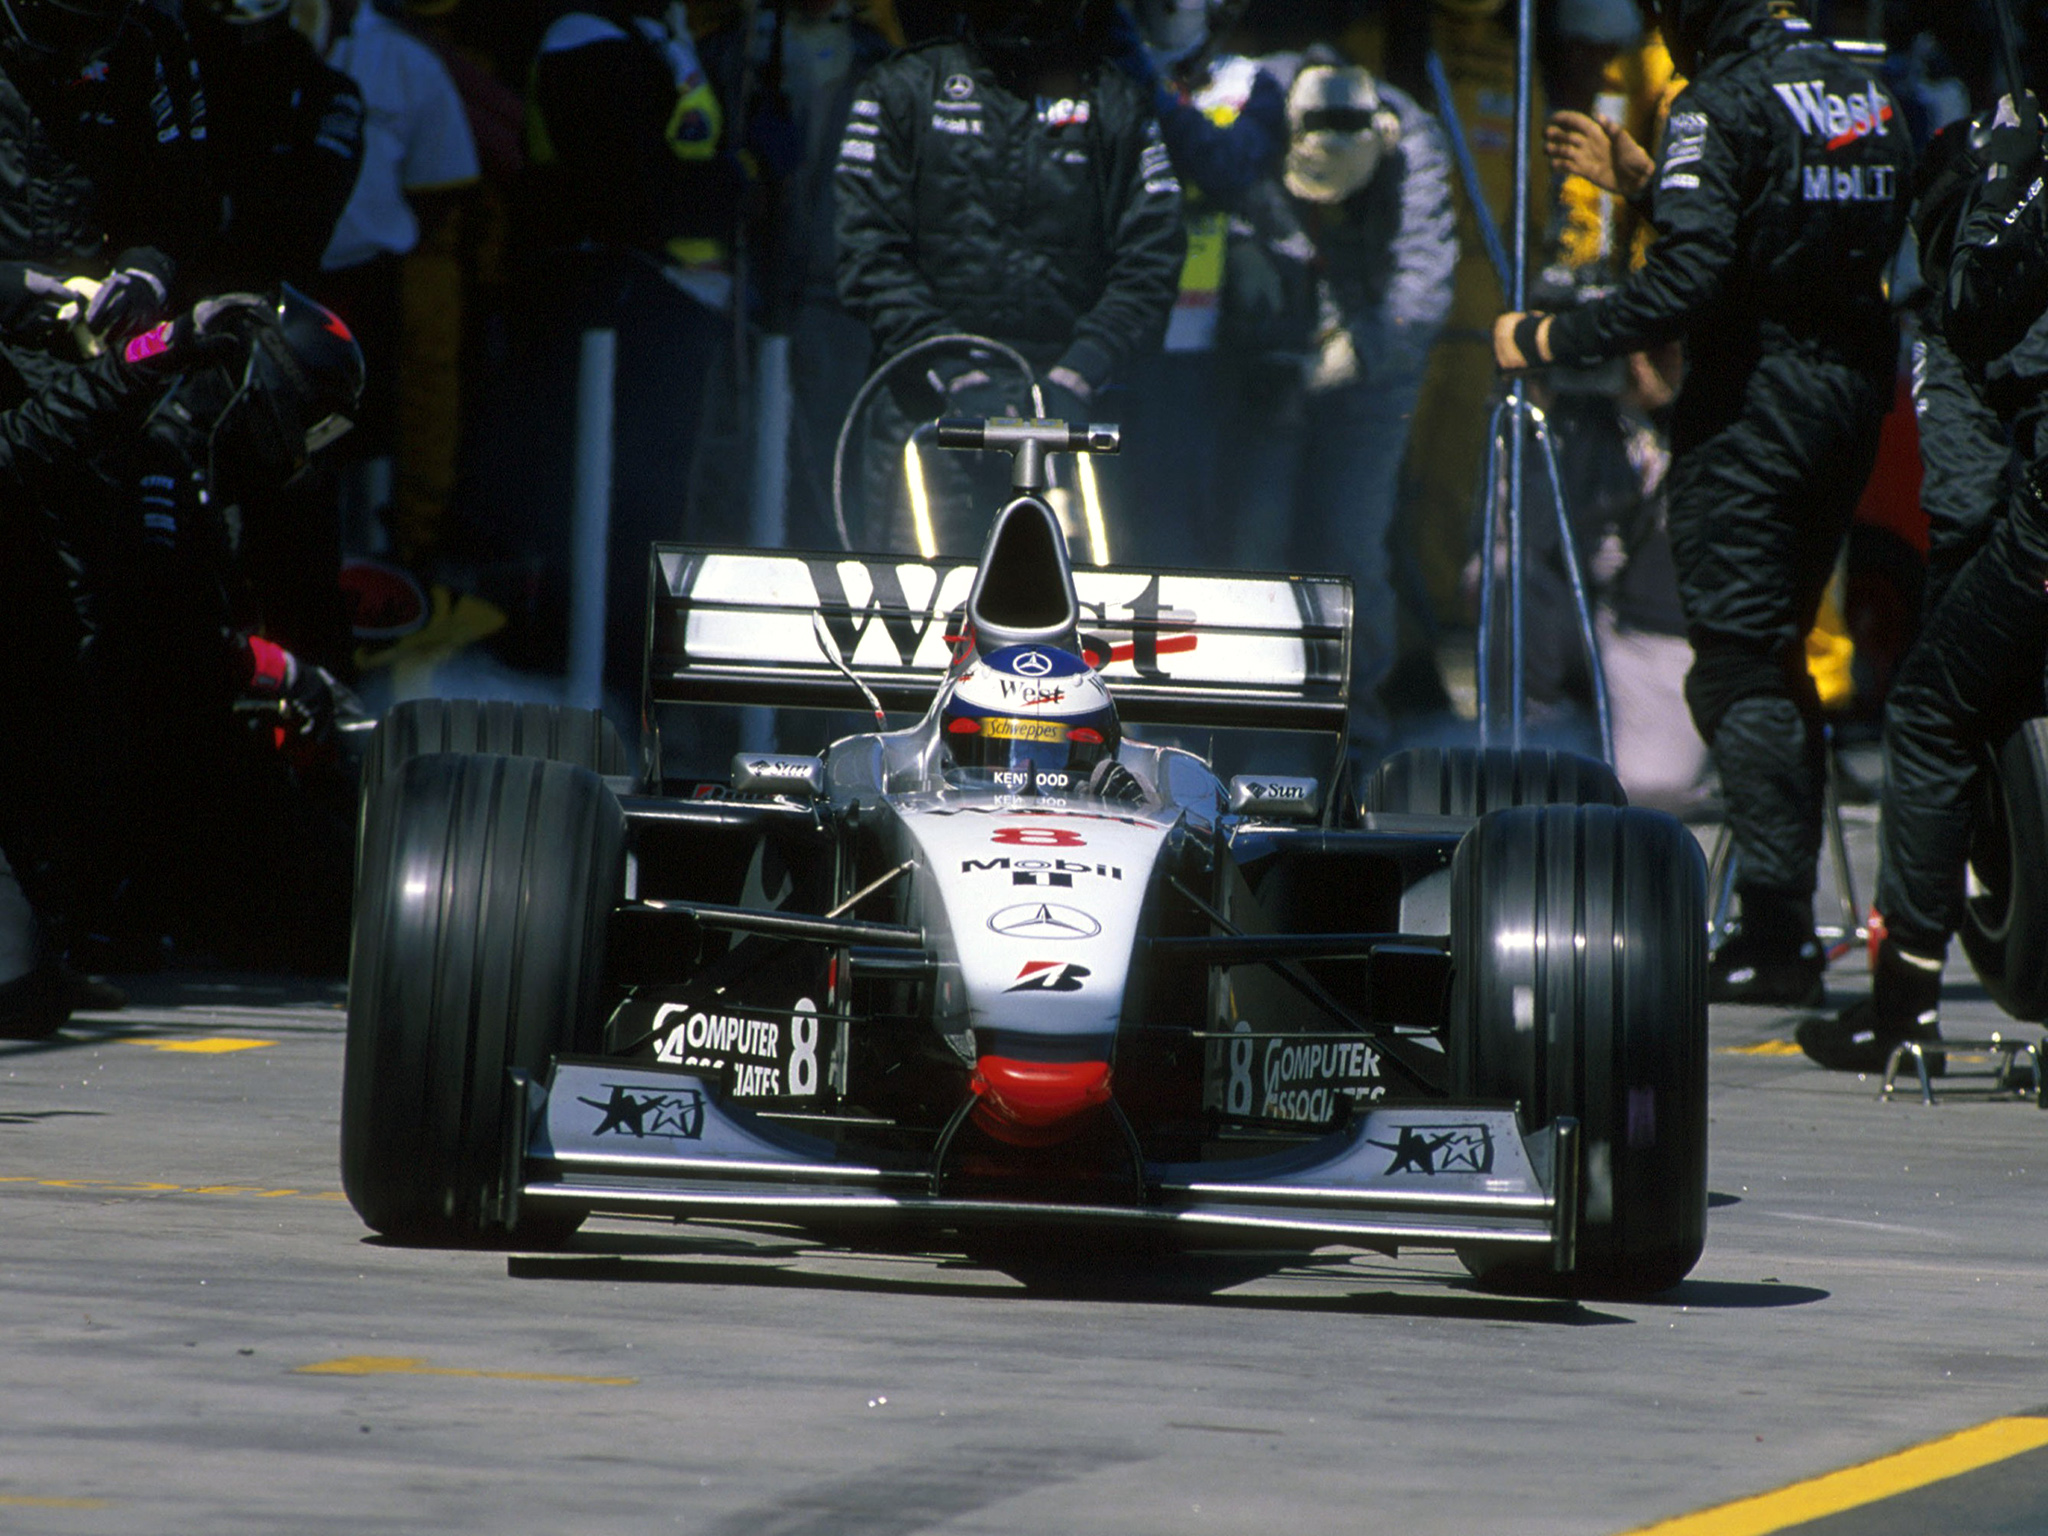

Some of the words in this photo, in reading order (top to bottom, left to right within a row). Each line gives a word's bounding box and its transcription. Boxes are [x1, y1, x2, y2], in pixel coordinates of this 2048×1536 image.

[1773, 79, 1889, 137] West
[797, 556, 1173, 679] Wt
[1000, 678, 1065, 705] West
[989, 718, 1058, 739] Schweppes
[1268, 783, 1304, 799] Sun
[990, 827, 1087, 847] 8
[961, 857, 1122, 880] Mobil
[652, 1002, 779, 1058] COMPUTER
[789, 997, 818, 1095] 8
[657, 1023, 780, 1096] AIATES
[1227, 1020, 1253, 1115] 8
